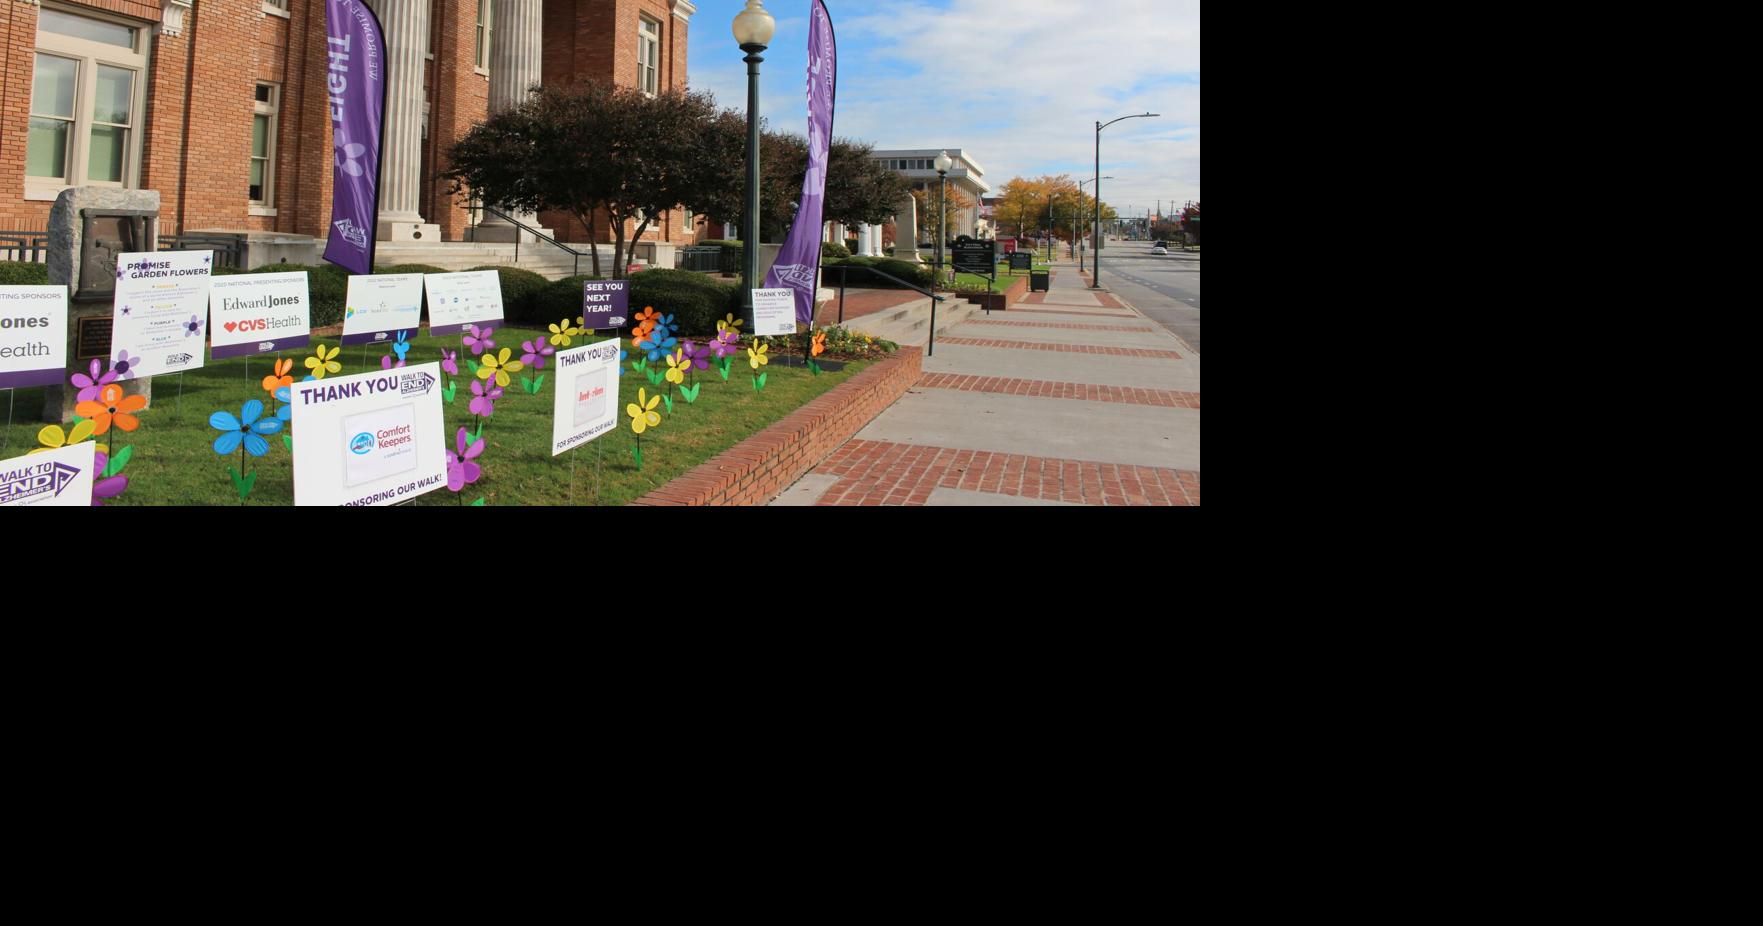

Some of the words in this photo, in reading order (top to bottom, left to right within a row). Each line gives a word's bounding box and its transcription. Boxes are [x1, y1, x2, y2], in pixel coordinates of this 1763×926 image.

[131, 270, 168, 279] GARDEN
[169, 268, 209, 277] FLOWERS
[586, 283, 603, 291] SEE
[605, 283, 623, 291] YOU
[586, 294, 611, 302] NEXT
[586, 304, 612, 313] YEAR!
[0, 316, 49, 328] ones
[0, 341, 50, 357] ealth
[560, 352, 587, 368] THANK
[587, 347, 602, 361] YOU
[401, 373, 415, 381] WALK
[415, 371, 424, 379] TO
[300, 381, 362, 404] THANK
[366, 375, 398, 394] YOU
[401, 379, 425, 390] END
[376, 424, 411, 440] Comfort
[556, 439, 566, 449] FOR
[566, 428, 595, 445] SPONSORING
[378, 434, 412, 450] Keepers
[0, 466, 33, 483] WALK
[36, 462, 52, 474] TO
[0, 485, 52, 502] ZHEIMER'S
[338, 489, 395, 507] NSORING
[397, 482, 416, 496] OUR
[417, 473, 442, 488] WALK!
